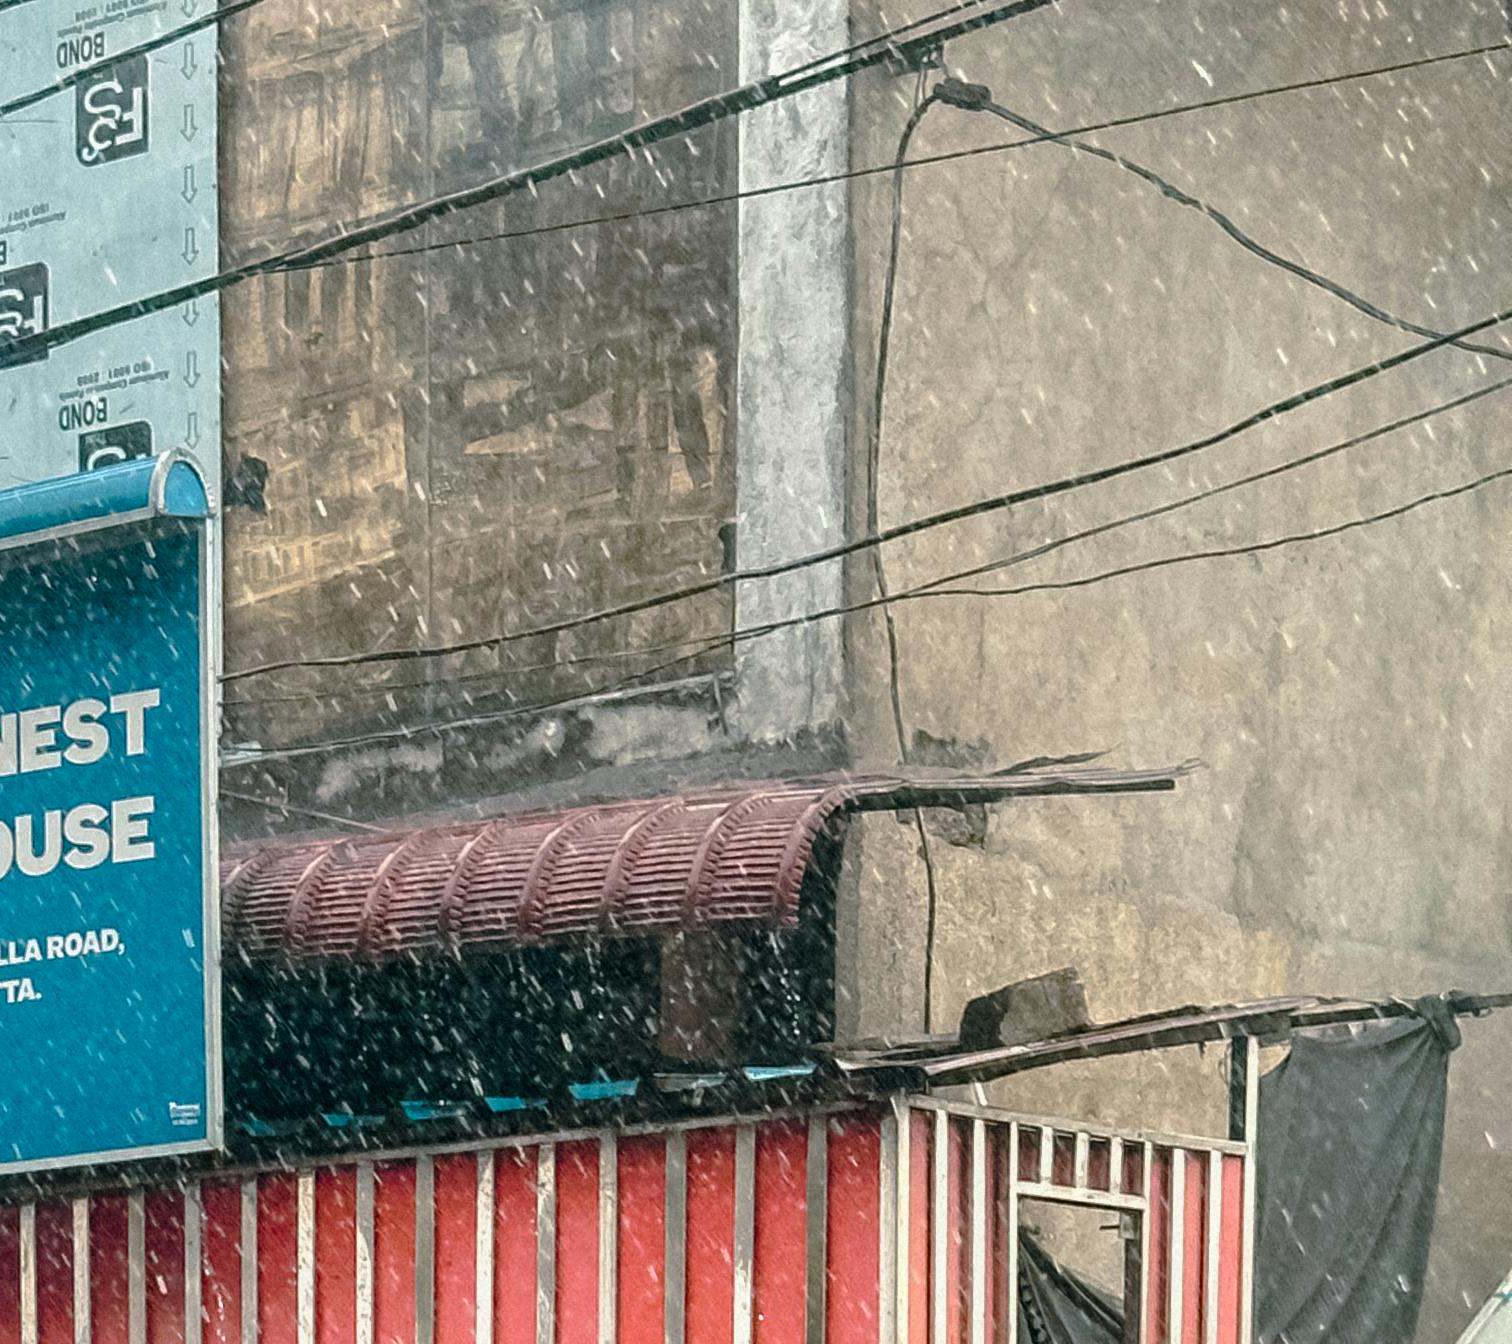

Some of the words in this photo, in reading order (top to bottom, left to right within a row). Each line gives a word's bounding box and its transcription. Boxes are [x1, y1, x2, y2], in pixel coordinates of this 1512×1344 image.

[57, 32, 104, 68] BOND
[59, 398, 107, 431] BOND
[47, 928, 125, 960] ROAD,
